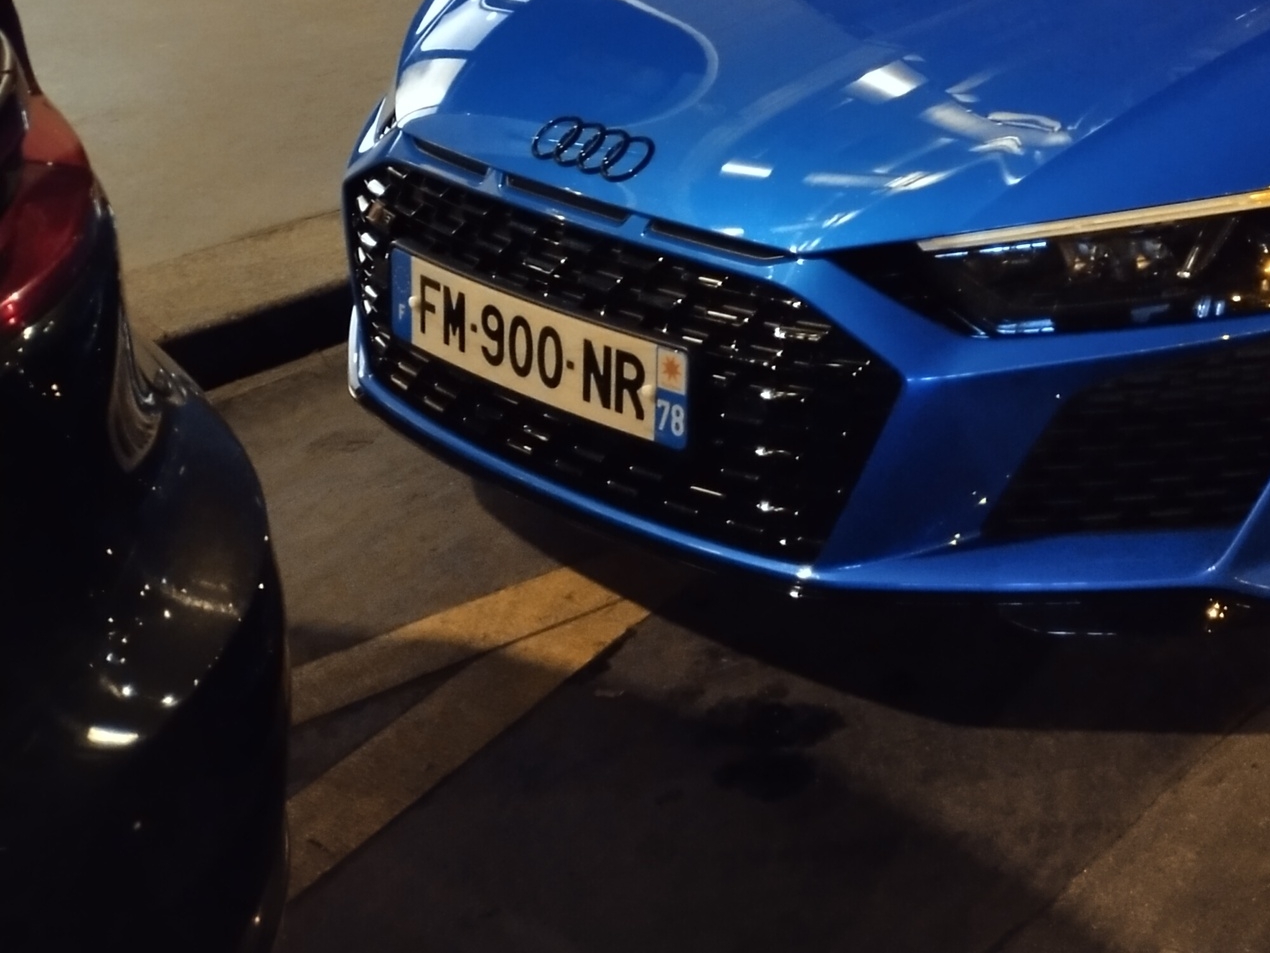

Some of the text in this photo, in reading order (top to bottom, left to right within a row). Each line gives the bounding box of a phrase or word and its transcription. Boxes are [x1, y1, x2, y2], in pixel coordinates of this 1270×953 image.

[398, 303, 407, 320] F
[419, 273, 647, 422] FM-900-NR
[656, 400, 686, 438] 78
